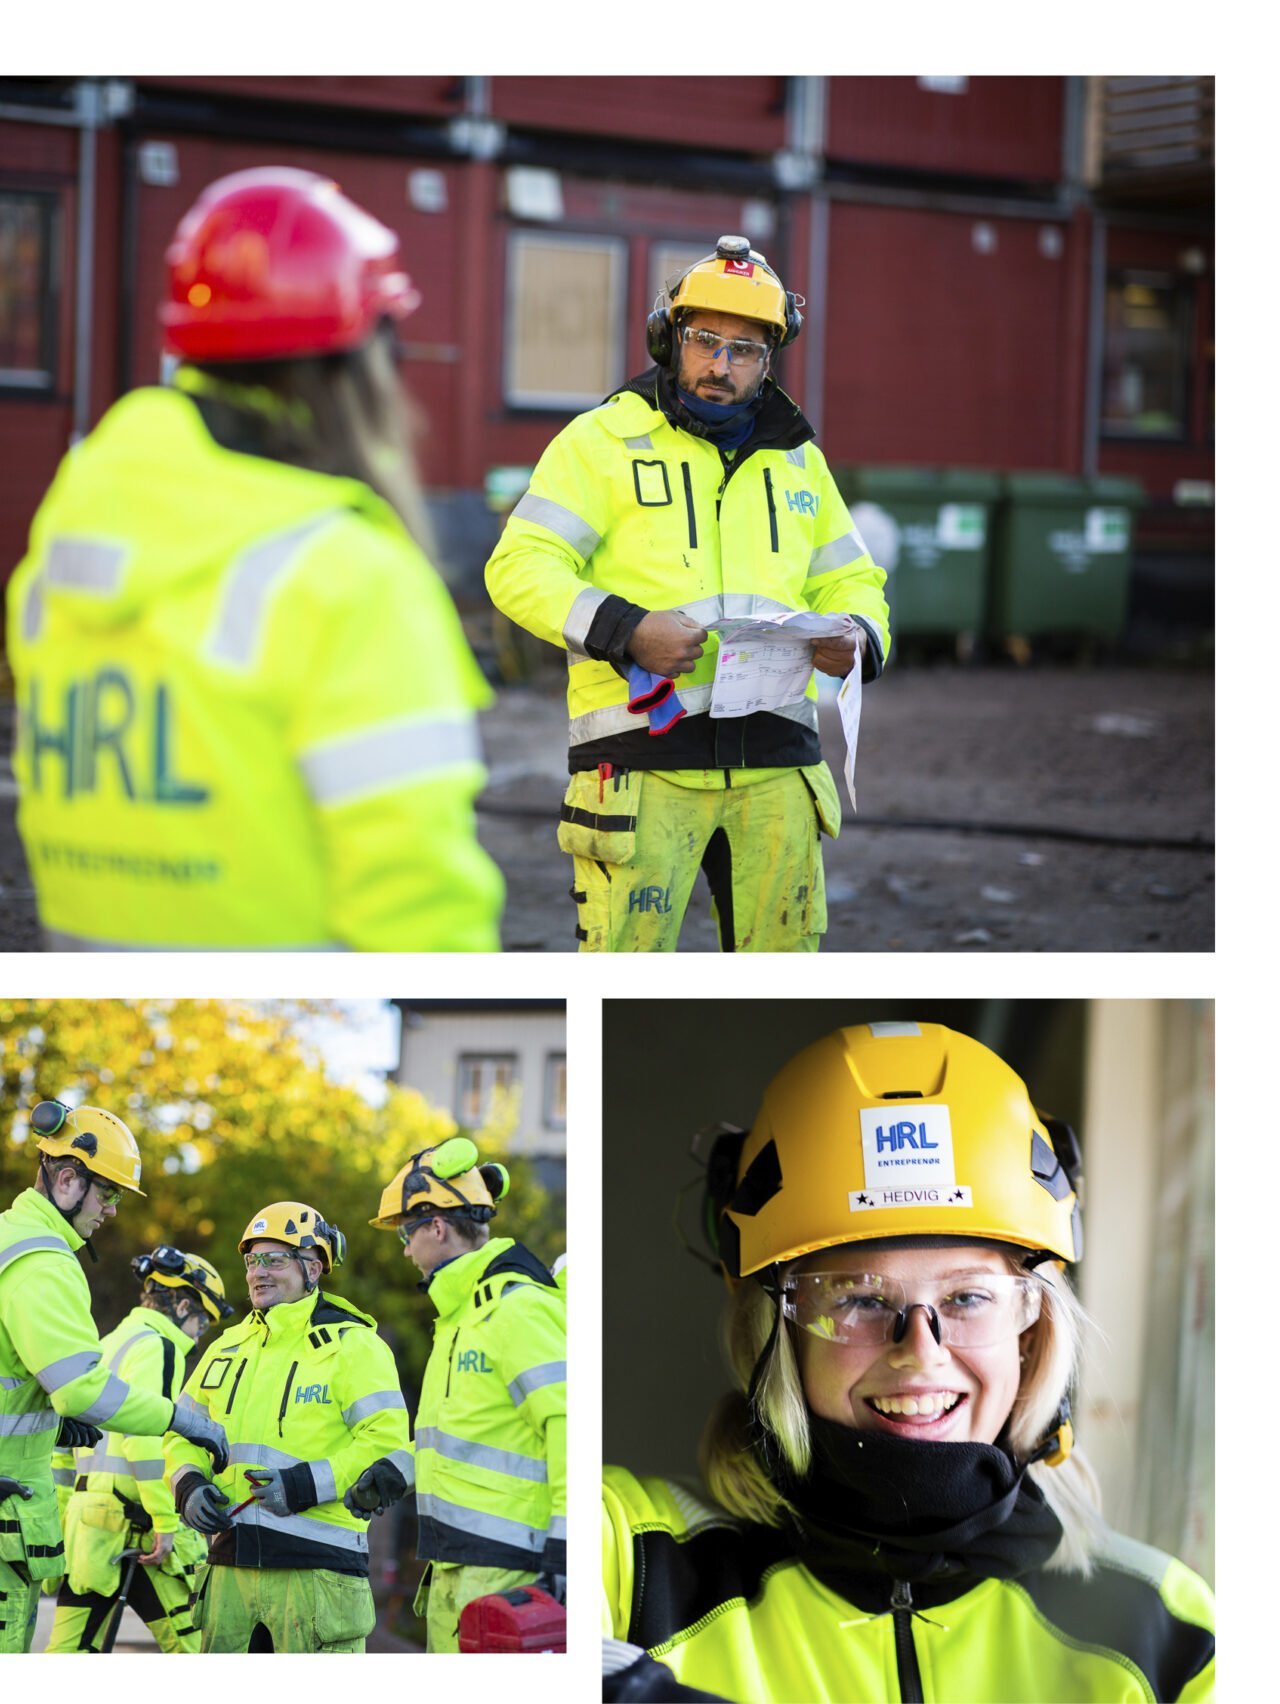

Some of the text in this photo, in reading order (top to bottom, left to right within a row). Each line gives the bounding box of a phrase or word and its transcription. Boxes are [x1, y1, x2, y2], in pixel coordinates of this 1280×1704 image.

[25, 668, 208, 803] HRL
[629, 886, 672, 914] HRL
[875, 1121, 939, 1153] HRL
[877, 1158, 940, 1167] ENTREPRENØR
[883, 1190, 939, 1203] HEDVIG
[457, 1349, 493, 1373] HRL
[295, 1384, 332, 1404] HRL
